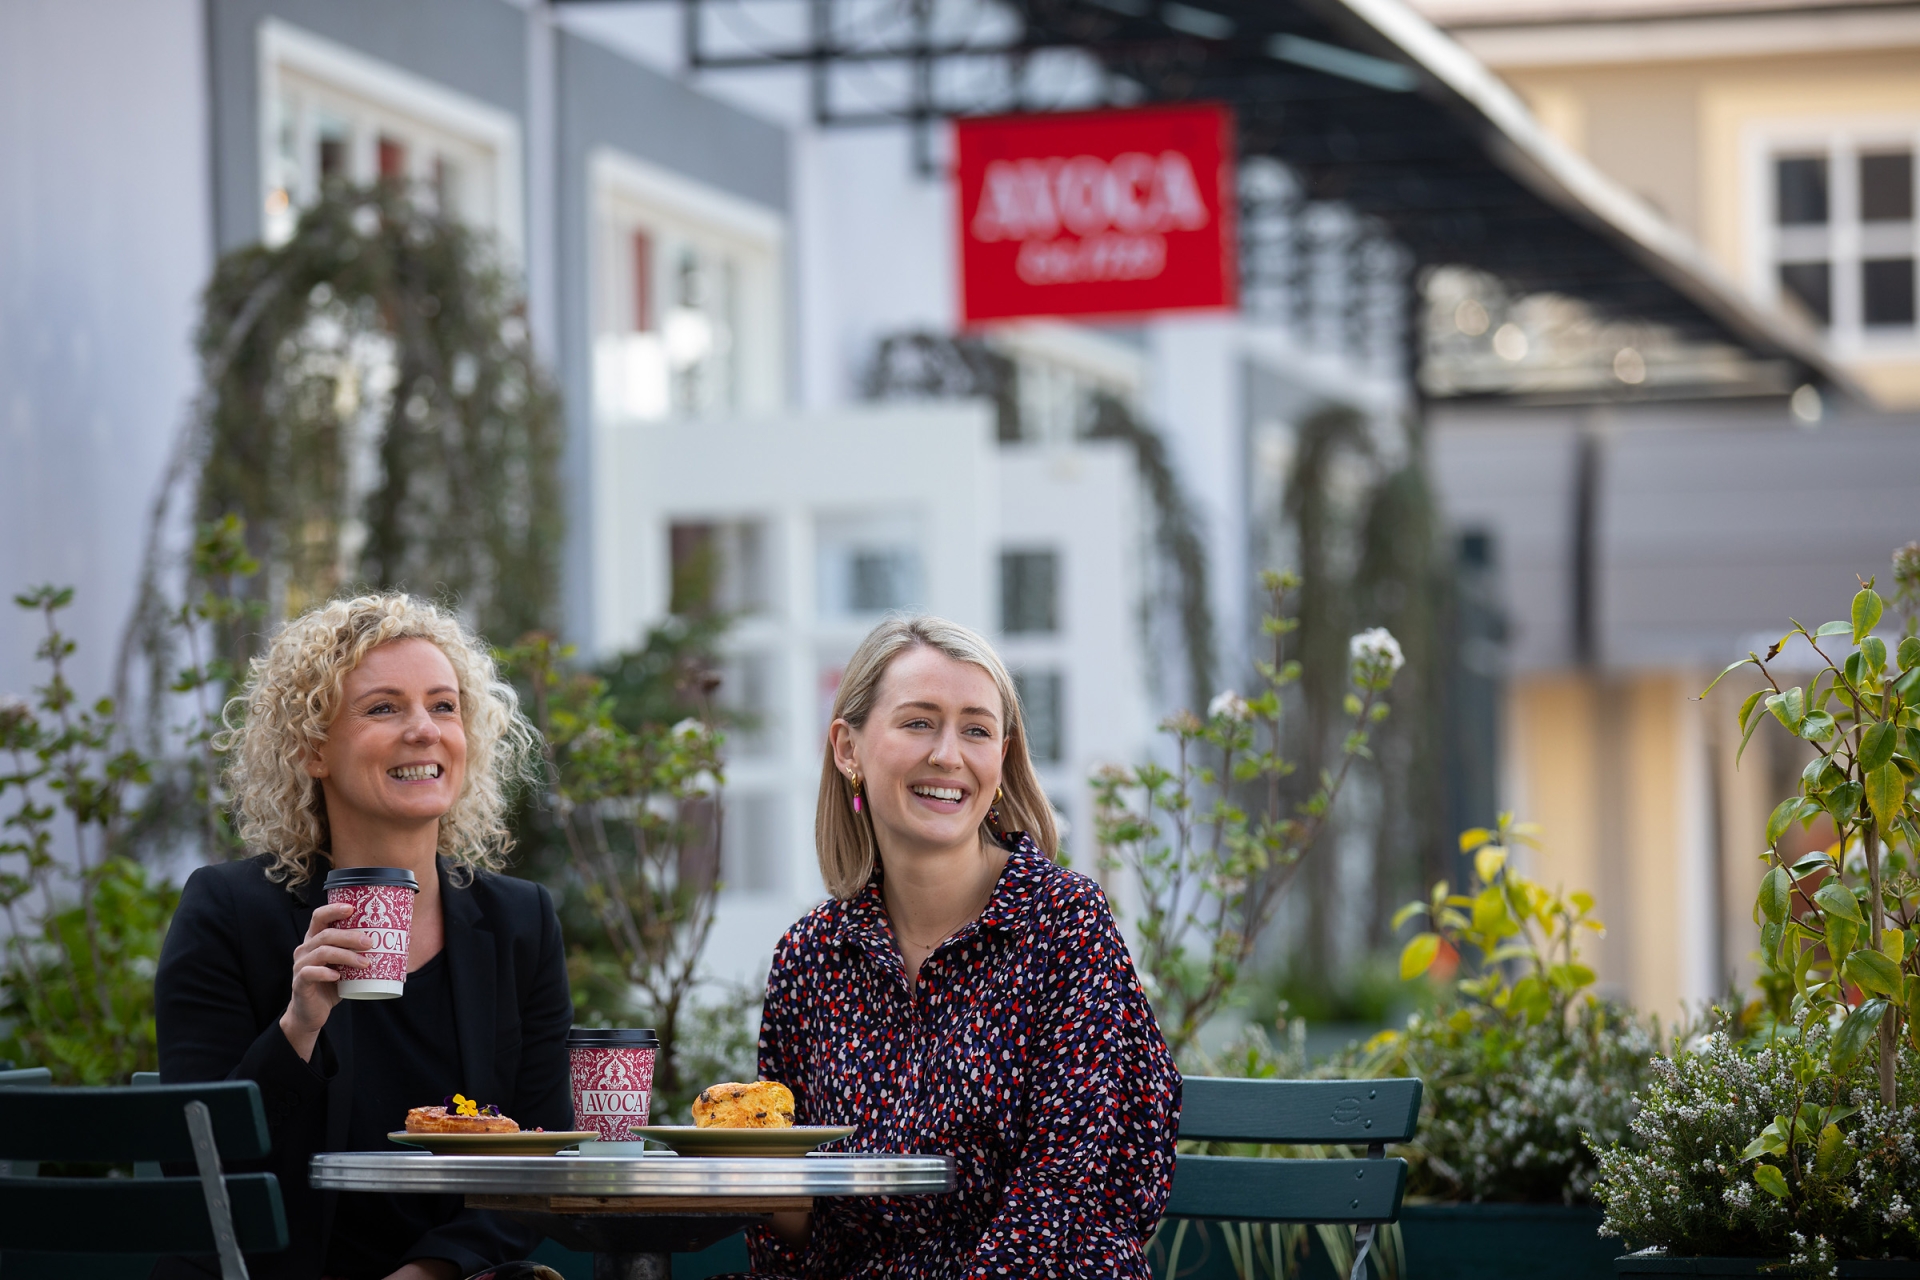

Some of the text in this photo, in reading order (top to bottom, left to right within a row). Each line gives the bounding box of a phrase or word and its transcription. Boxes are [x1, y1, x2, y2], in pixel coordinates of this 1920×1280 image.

[972, 151, 1208, 242] AVOCA
[363, 930, 403, 951] OCA
[585, 1092, 644, 1112] AVOCA
